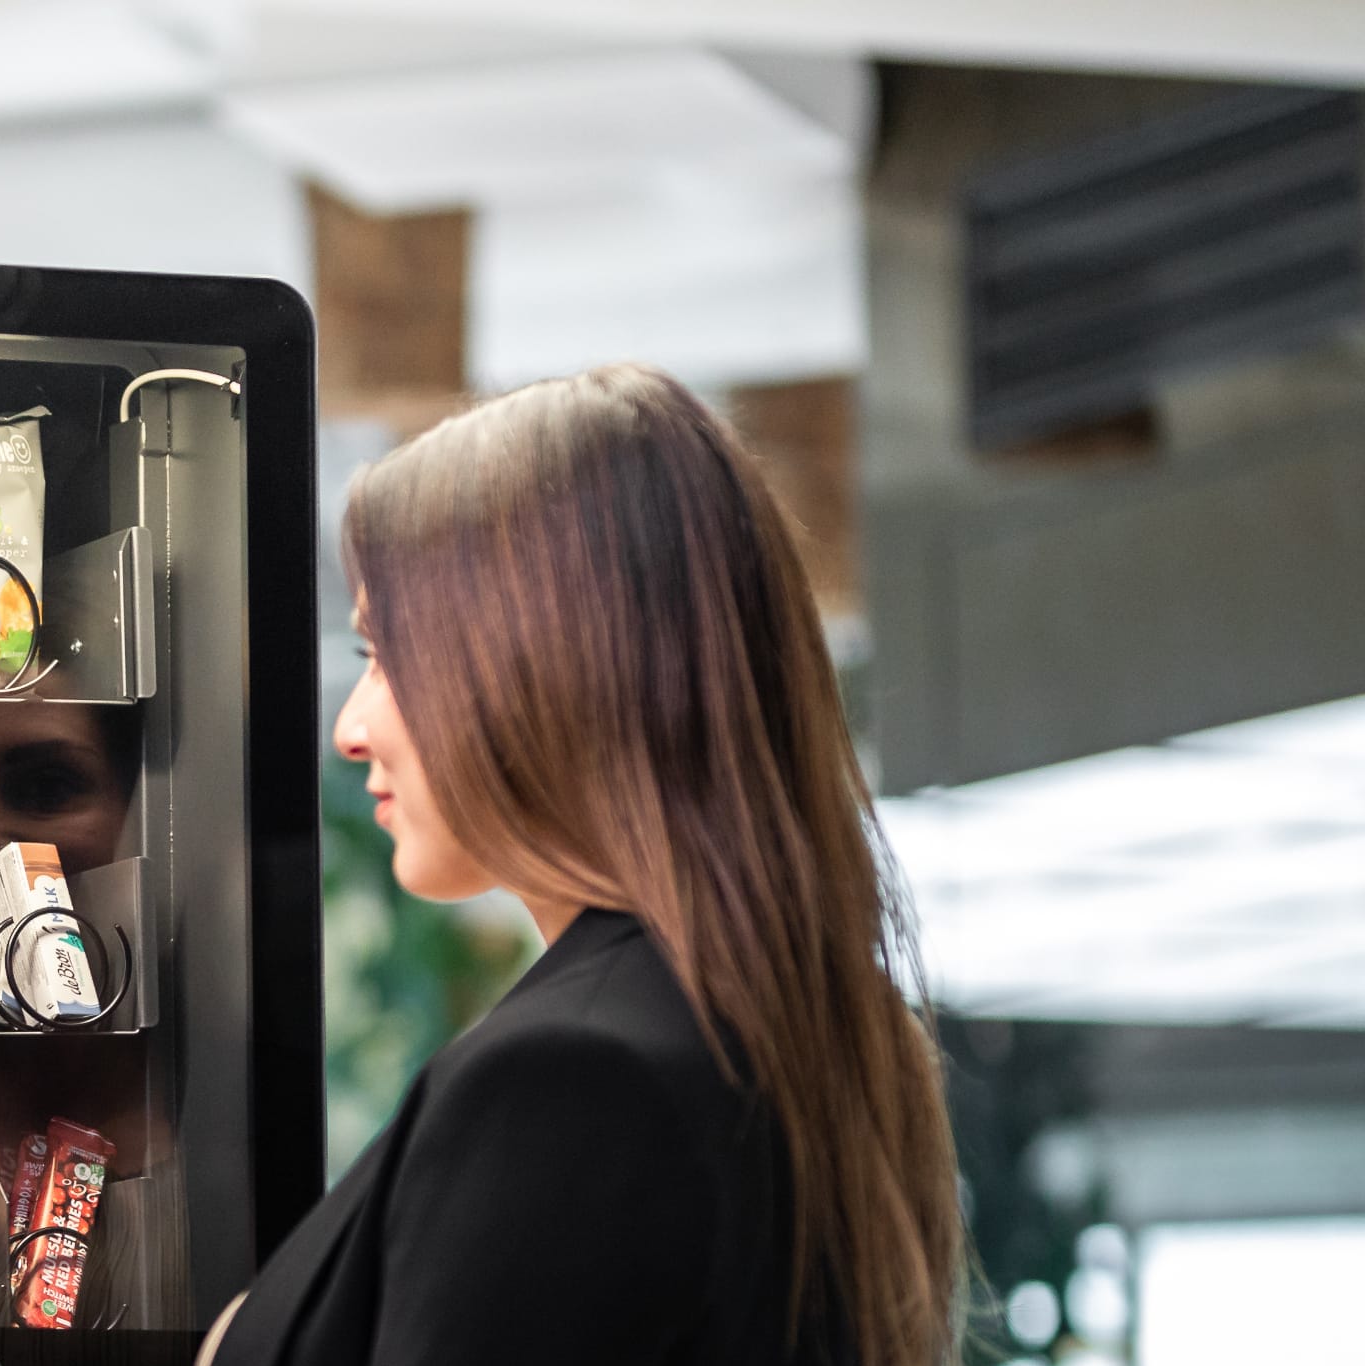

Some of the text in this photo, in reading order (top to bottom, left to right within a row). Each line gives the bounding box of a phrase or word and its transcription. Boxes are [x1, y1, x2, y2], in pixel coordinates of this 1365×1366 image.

[44, 886, 64, 923] MLK
[55, 948, 82, 996] deBron
[53, 1215, 66, 1227] &
[55, 1199, 83, 1290] RED BERIES
[53, 1297, 76, 1314] WEET
